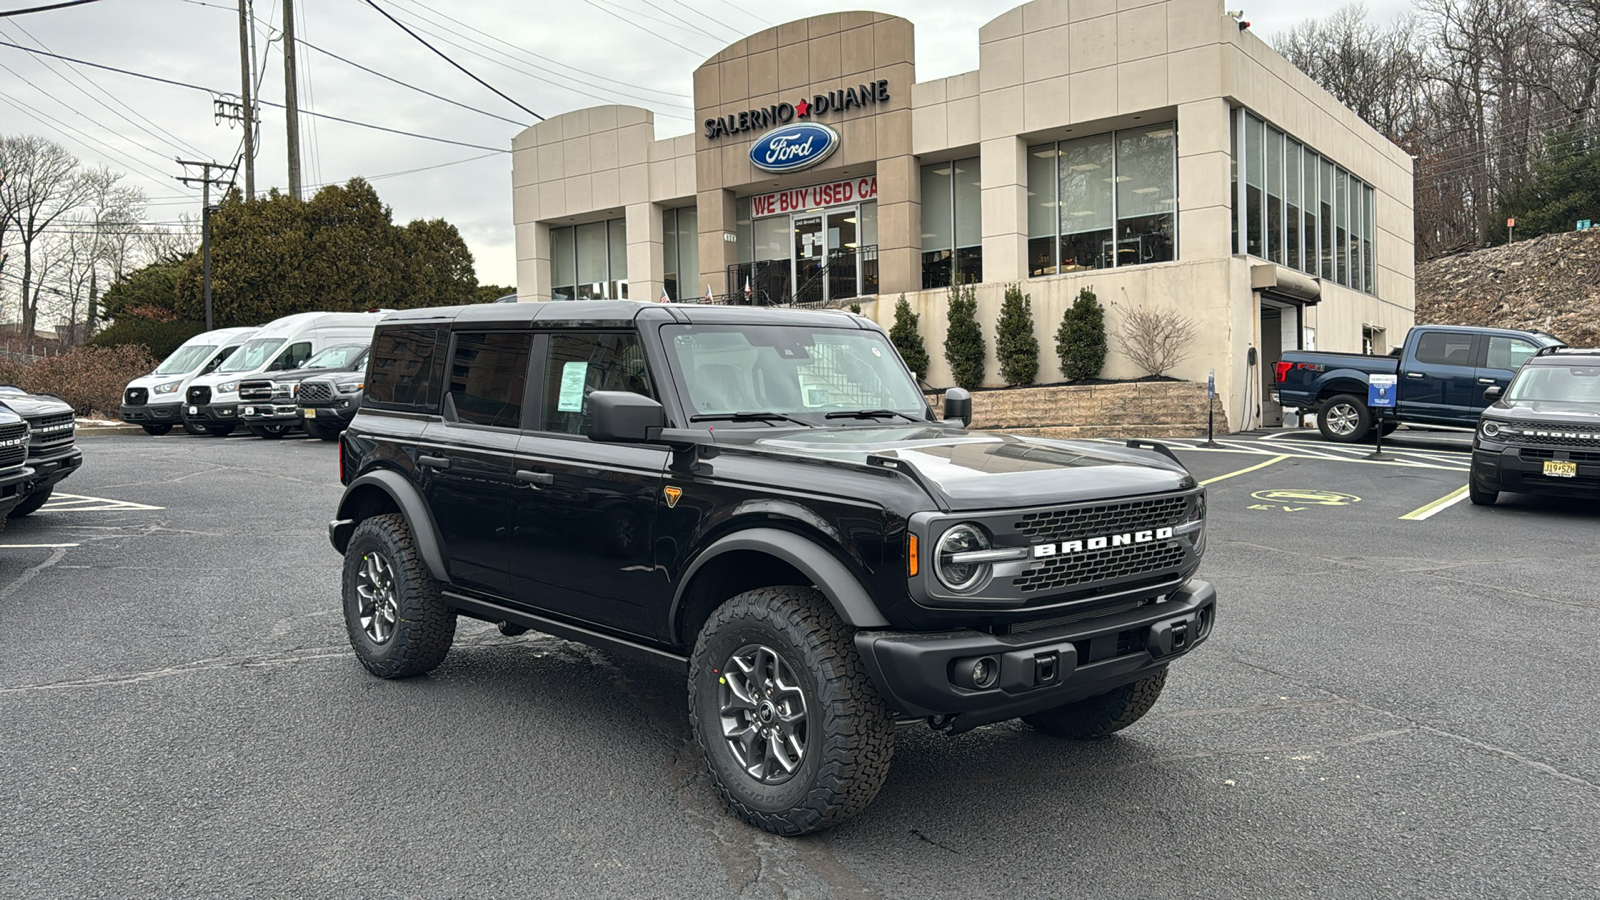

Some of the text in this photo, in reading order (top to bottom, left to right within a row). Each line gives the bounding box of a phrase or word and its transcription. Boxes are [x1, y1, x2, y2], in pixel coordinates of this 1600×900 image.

[704, 79, 890, 139] SALERNO DUANE
[765, 133, 813, 163] Ford
[753, 177, 878, 215] WE BUY USED CA
[42, 423, 73, 433] BRONCO
[1034, 526, 1173, 558] BRONCO
